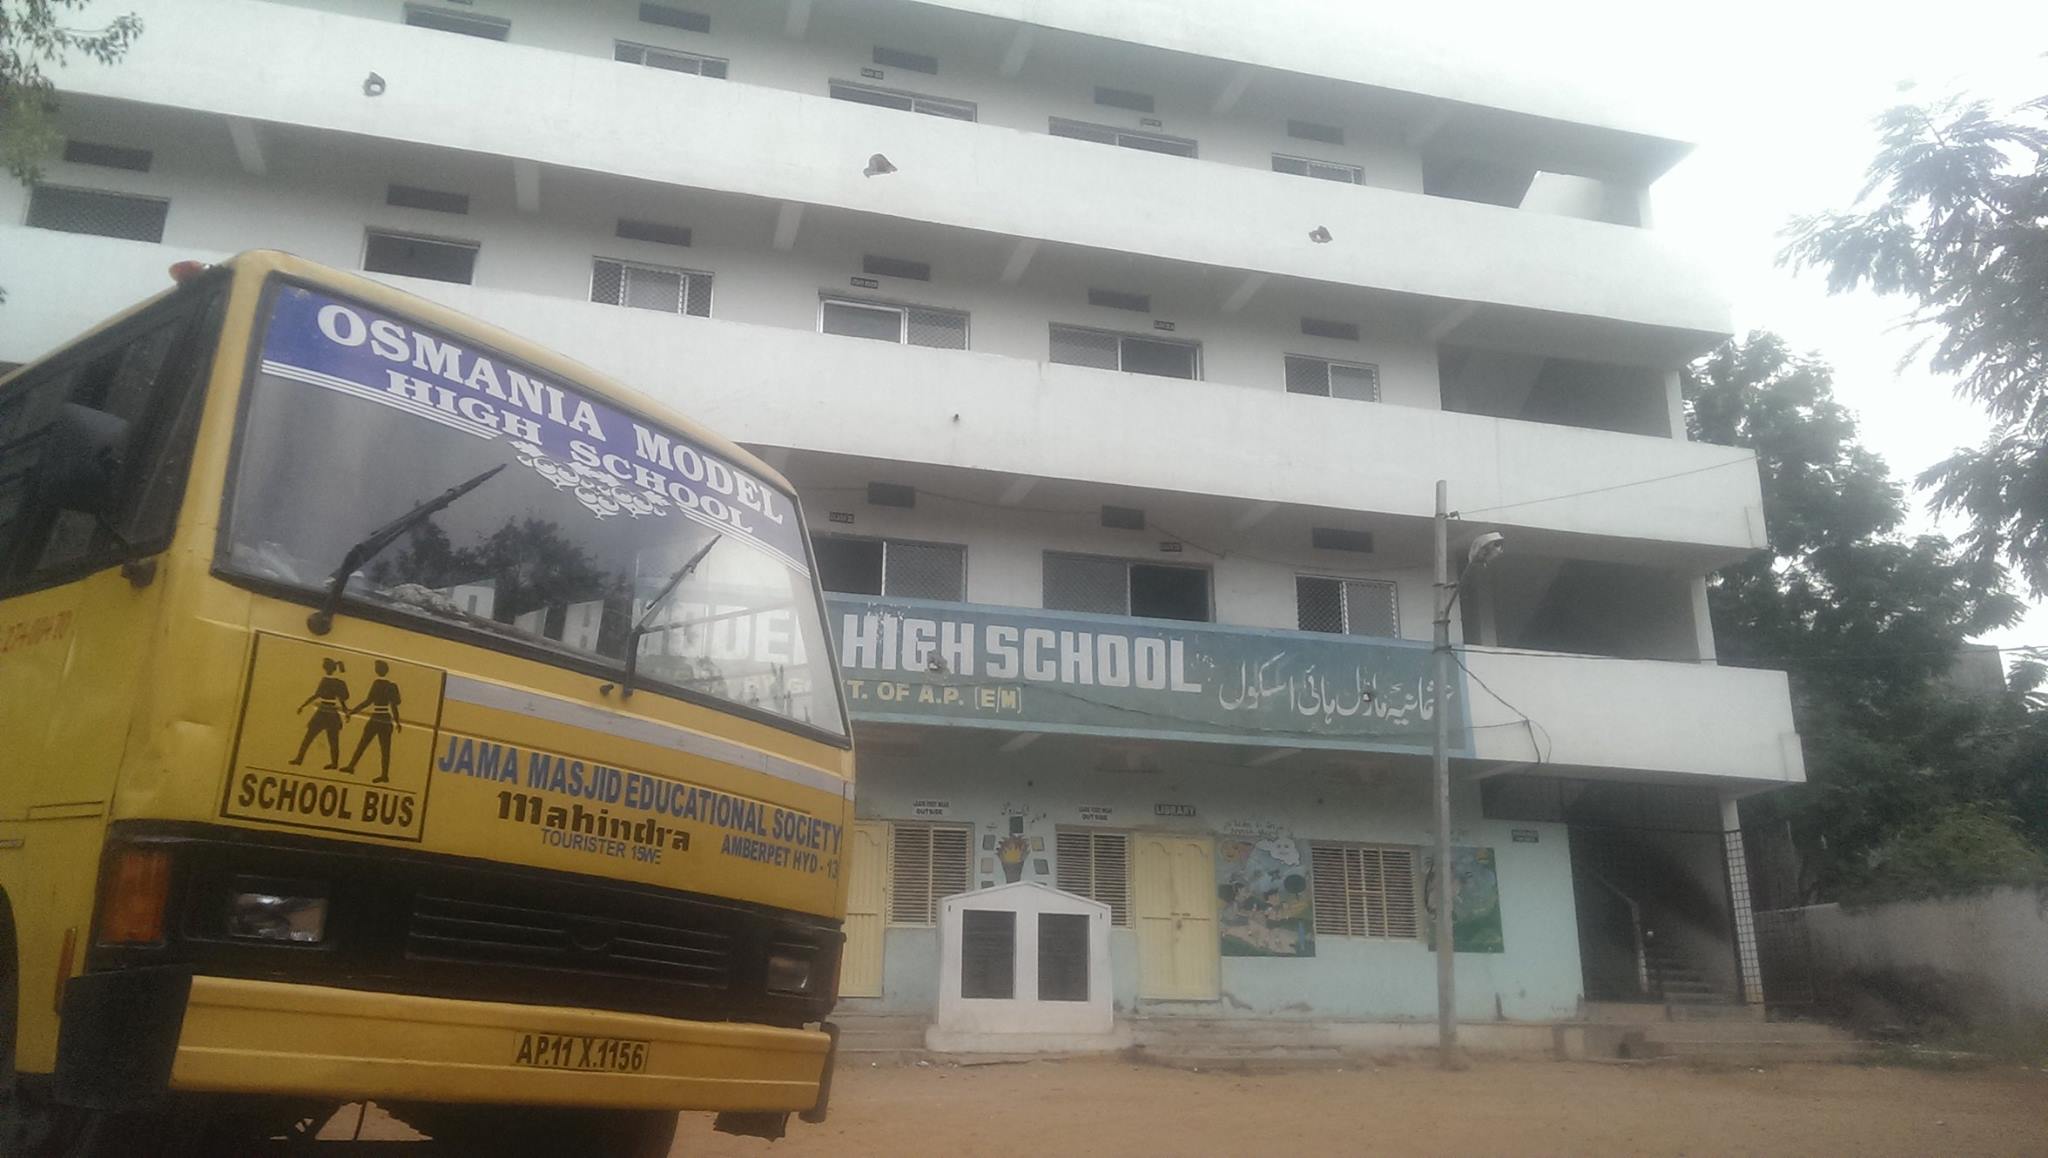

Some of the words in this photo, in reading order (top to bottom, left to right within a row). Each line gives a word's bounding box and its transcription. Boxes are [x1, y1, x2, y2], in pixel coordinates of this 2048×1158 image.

[317, 304, 606, 441] OSMANIA
[632, 423, 783, 525] MODEL
[386, 369, 543, 445] HIGH
[569, 439, 753, 533] SCHOOL
[841, 613, 975, 676] HIGH
[985, 624, 1202, 693] SCHOOL
[877, 681, 910, 701] OF
[918, 685, 964, 706] A.P.
[238, 773, 352, 820] SCHOOL
[361, 790, 415, 828] BUS
[438, 735, 518, 785] JAMA
[527, 751, 622, 804] MASJID
[624, 773, 768, 837] EDUCATIONAL
[772, 807, 843, 855] SOCIETY
[541, 828, 625, 858] TOURISTER
[720, 833, 791, 868] AMBERPET
[792, 848, 818, 875] HYD
